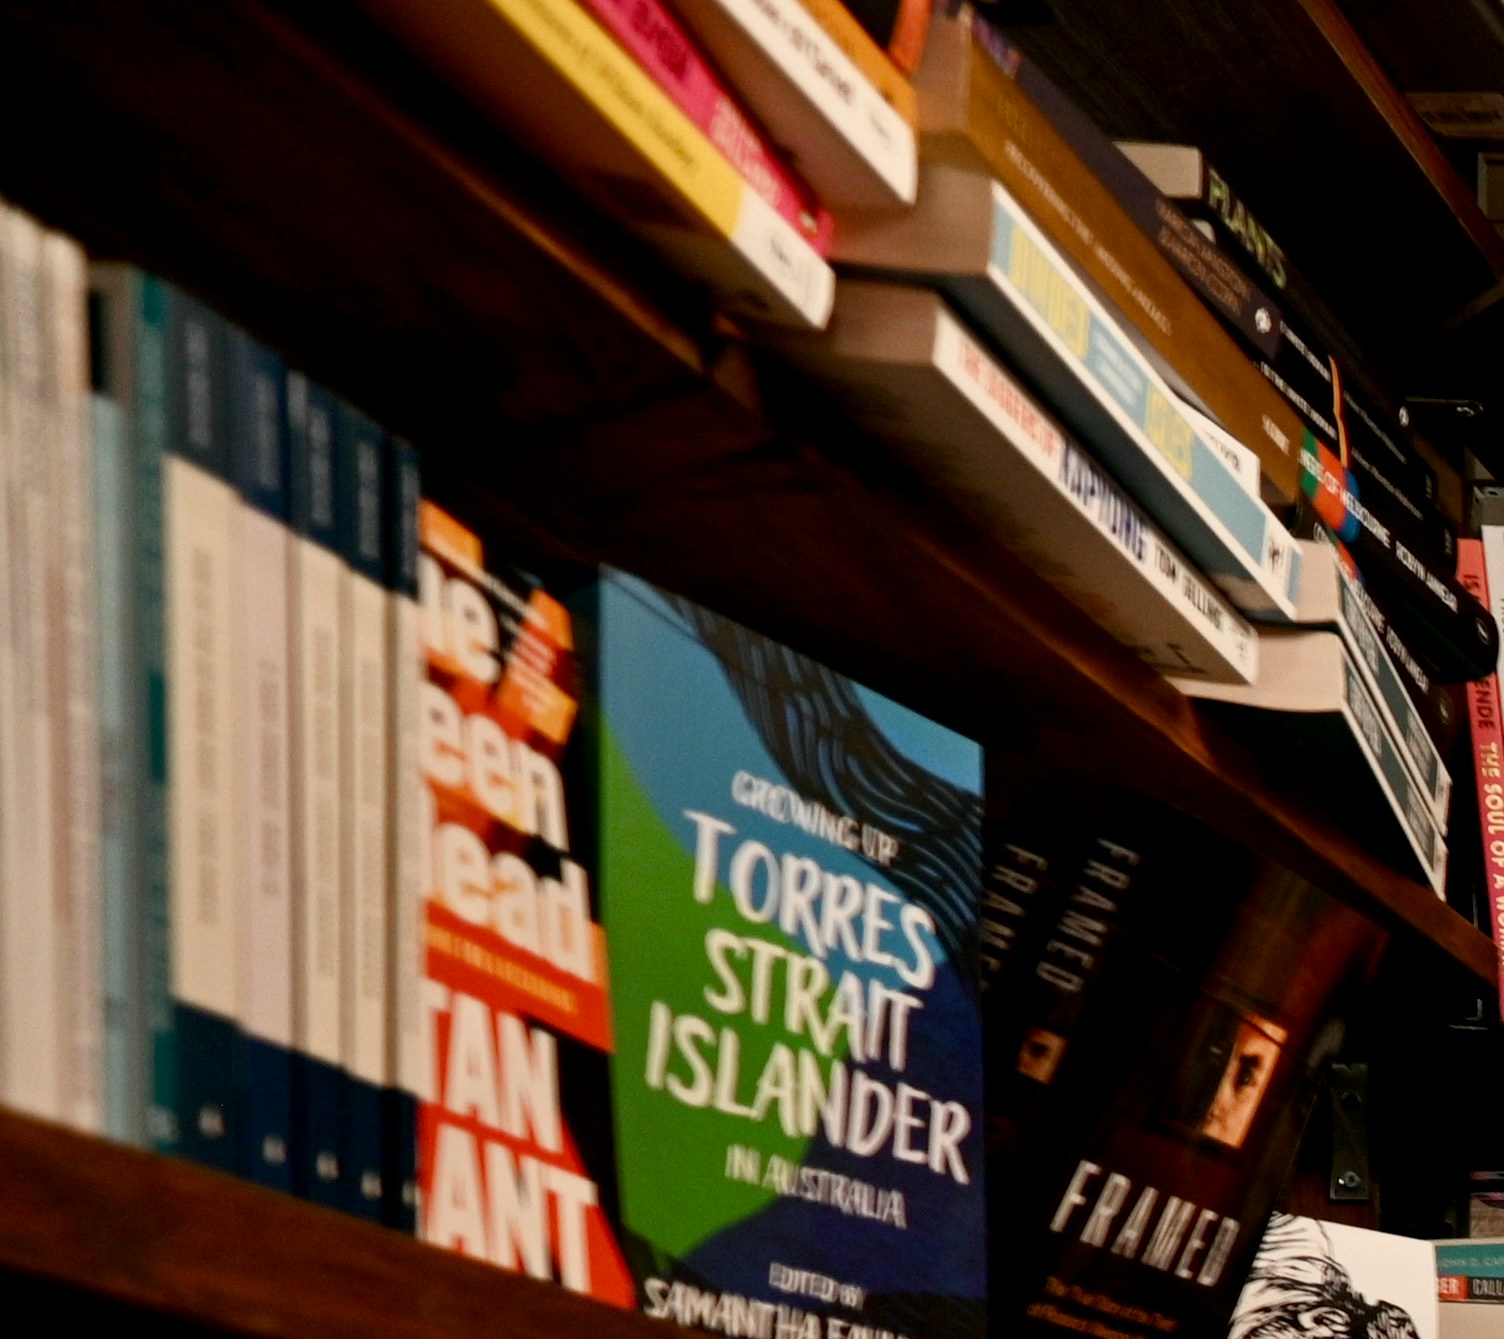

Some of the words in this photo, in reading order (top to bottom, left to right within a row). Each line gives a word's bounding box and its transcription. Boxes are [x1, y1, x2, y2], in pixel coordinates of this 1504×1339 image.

[683, 810, 938, 992] TORRES
[703, 928, 922, 1072] STRAIT
[645, 1001, 970, 1185] ISLANDER
